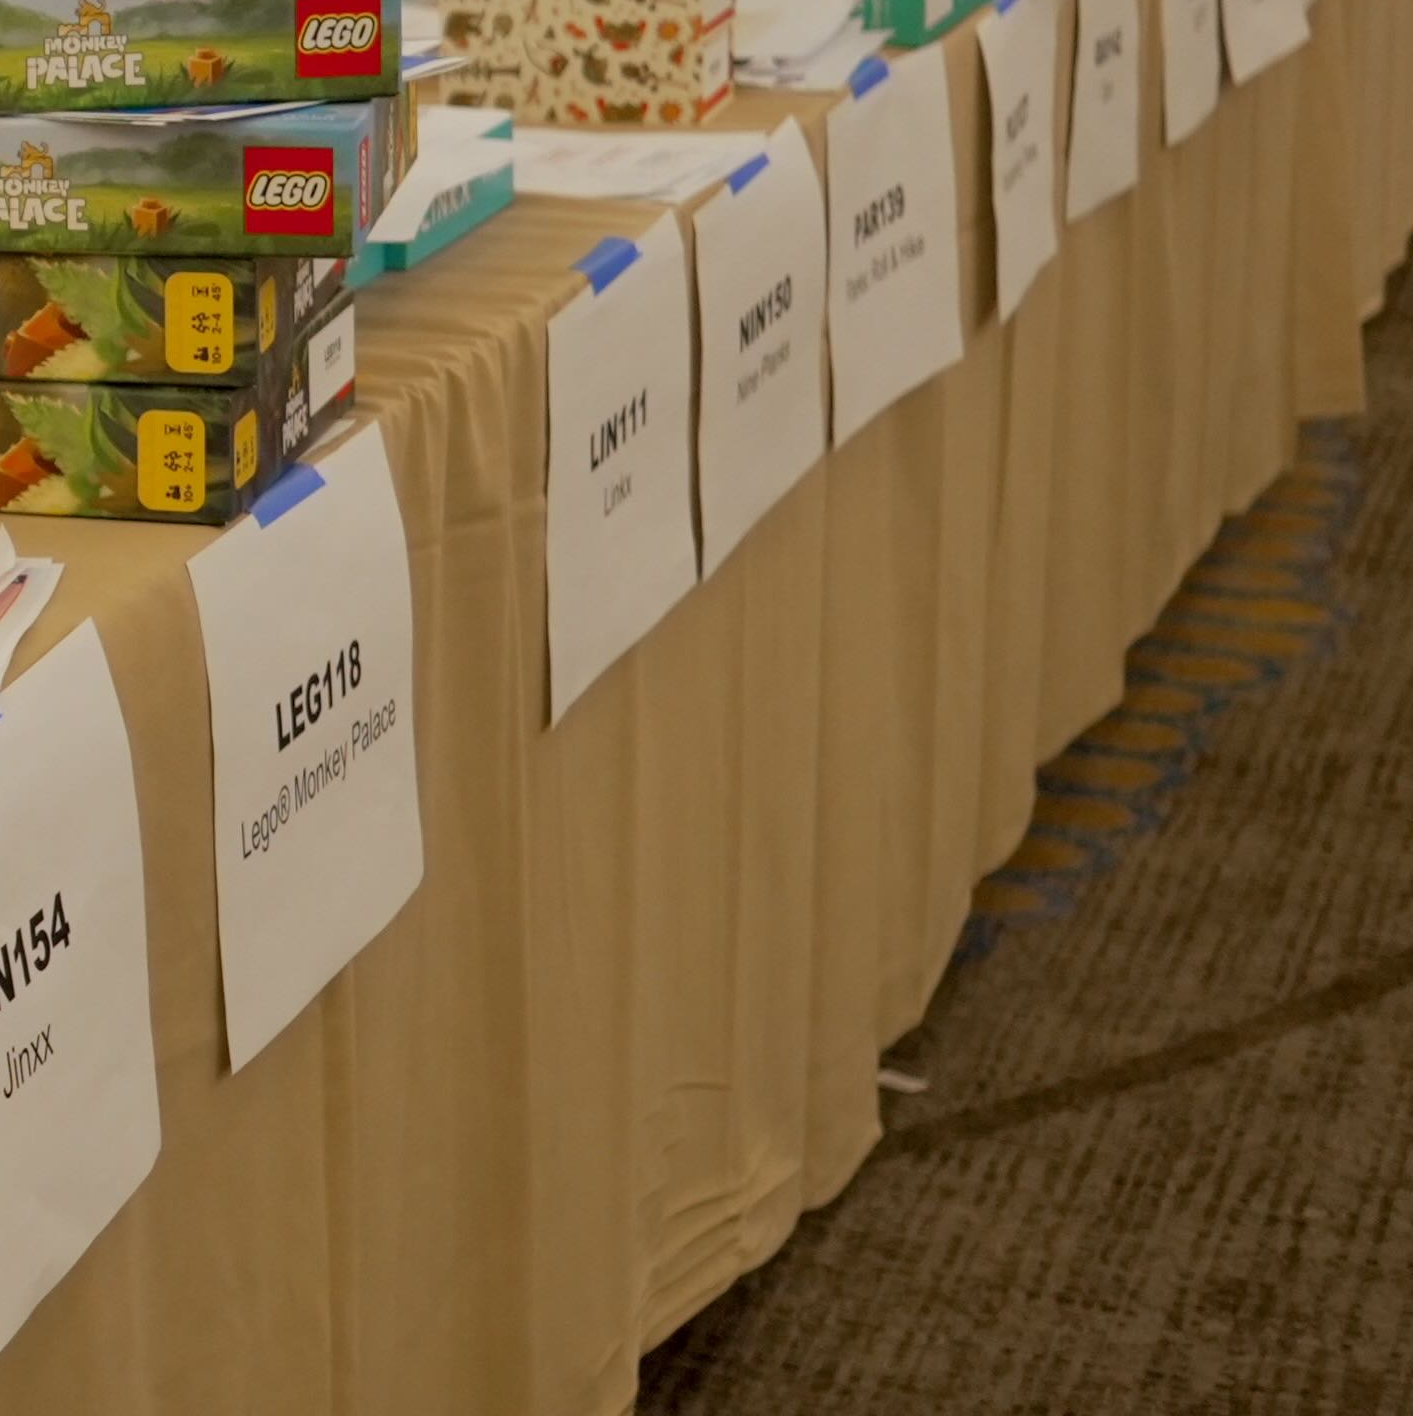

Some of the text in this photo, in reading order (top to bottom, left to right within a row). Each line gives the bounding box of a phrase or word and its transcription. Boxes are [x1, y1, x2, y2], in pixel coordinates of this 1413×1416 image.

[44, 33, 127, 56] MONKEY
[299, 14, 377, 53] LEGO
[26, 52, 147, 90] PALACE
[248, 172, 329, 210] LEGO
[739, 272, 792, 354] NIN150
[590, 386, 647, 473] LIN111
[603, 472, 632, 518] Linkx
[275, 638, 362, 753] LEG118
[240, 697, 397, 861] Lego® Monkey Palace
[2, 1023, 54, 1099] Jinxx
